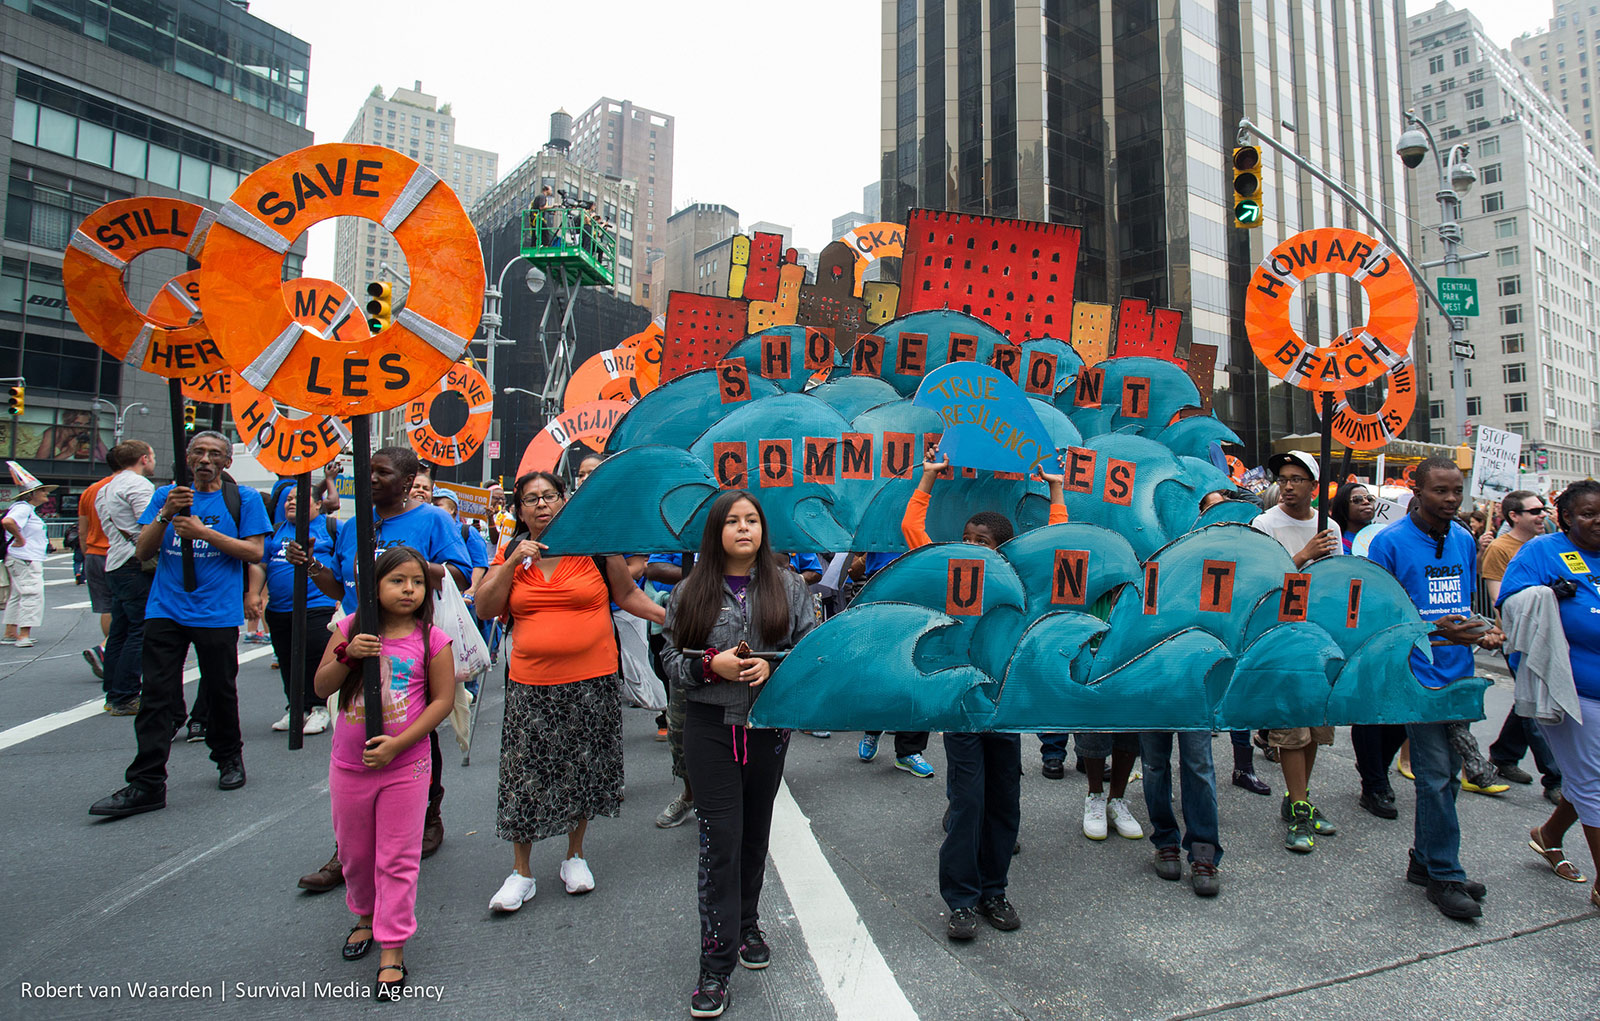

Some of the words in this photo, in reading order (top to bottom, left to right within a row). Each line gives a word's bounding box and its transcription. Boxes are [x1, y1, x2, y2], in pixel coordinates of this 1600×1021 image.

[257, 158, 383, 226] SAVE
[96, 208, 189, 250] STILL
[1256, 238, 1390, 298] HOWARD
[1441, 282, 1472, 292] CENTRAL
[1442, 292, 1460, 301] PARK
[1444, 302, 1462, 311] WEST
[306, 353, 412, 397] LES
[722, 332, 1146, 414] SHOREFRONT
[1274, 337, 1391, 379] BEACH
[447, 371, 486, 405] SAVE
[927, 376, 1000, 400] TRUE
[1391, 361, 1411, 394] OUR
[241, 401, 352, 462] HOUSE
[411, 402, 479, 459] EDGEMERE
[941, 404, 1053, 471] RESILIENCY
[1482, 427, 1510, 446] STOP
[718, 439, 1131, 499] COMMUES
[1480, 443, 1517, 465] WASTING
[1481, 456, 1507, 471] TIME!
[1424, 563, 1463, 578] PEOPLE'S
[1429, 579, 1461, 592] CLIMATE
[952, 558, 1360, 620] UNITE!
[1419, 607, 1450, 616] September
